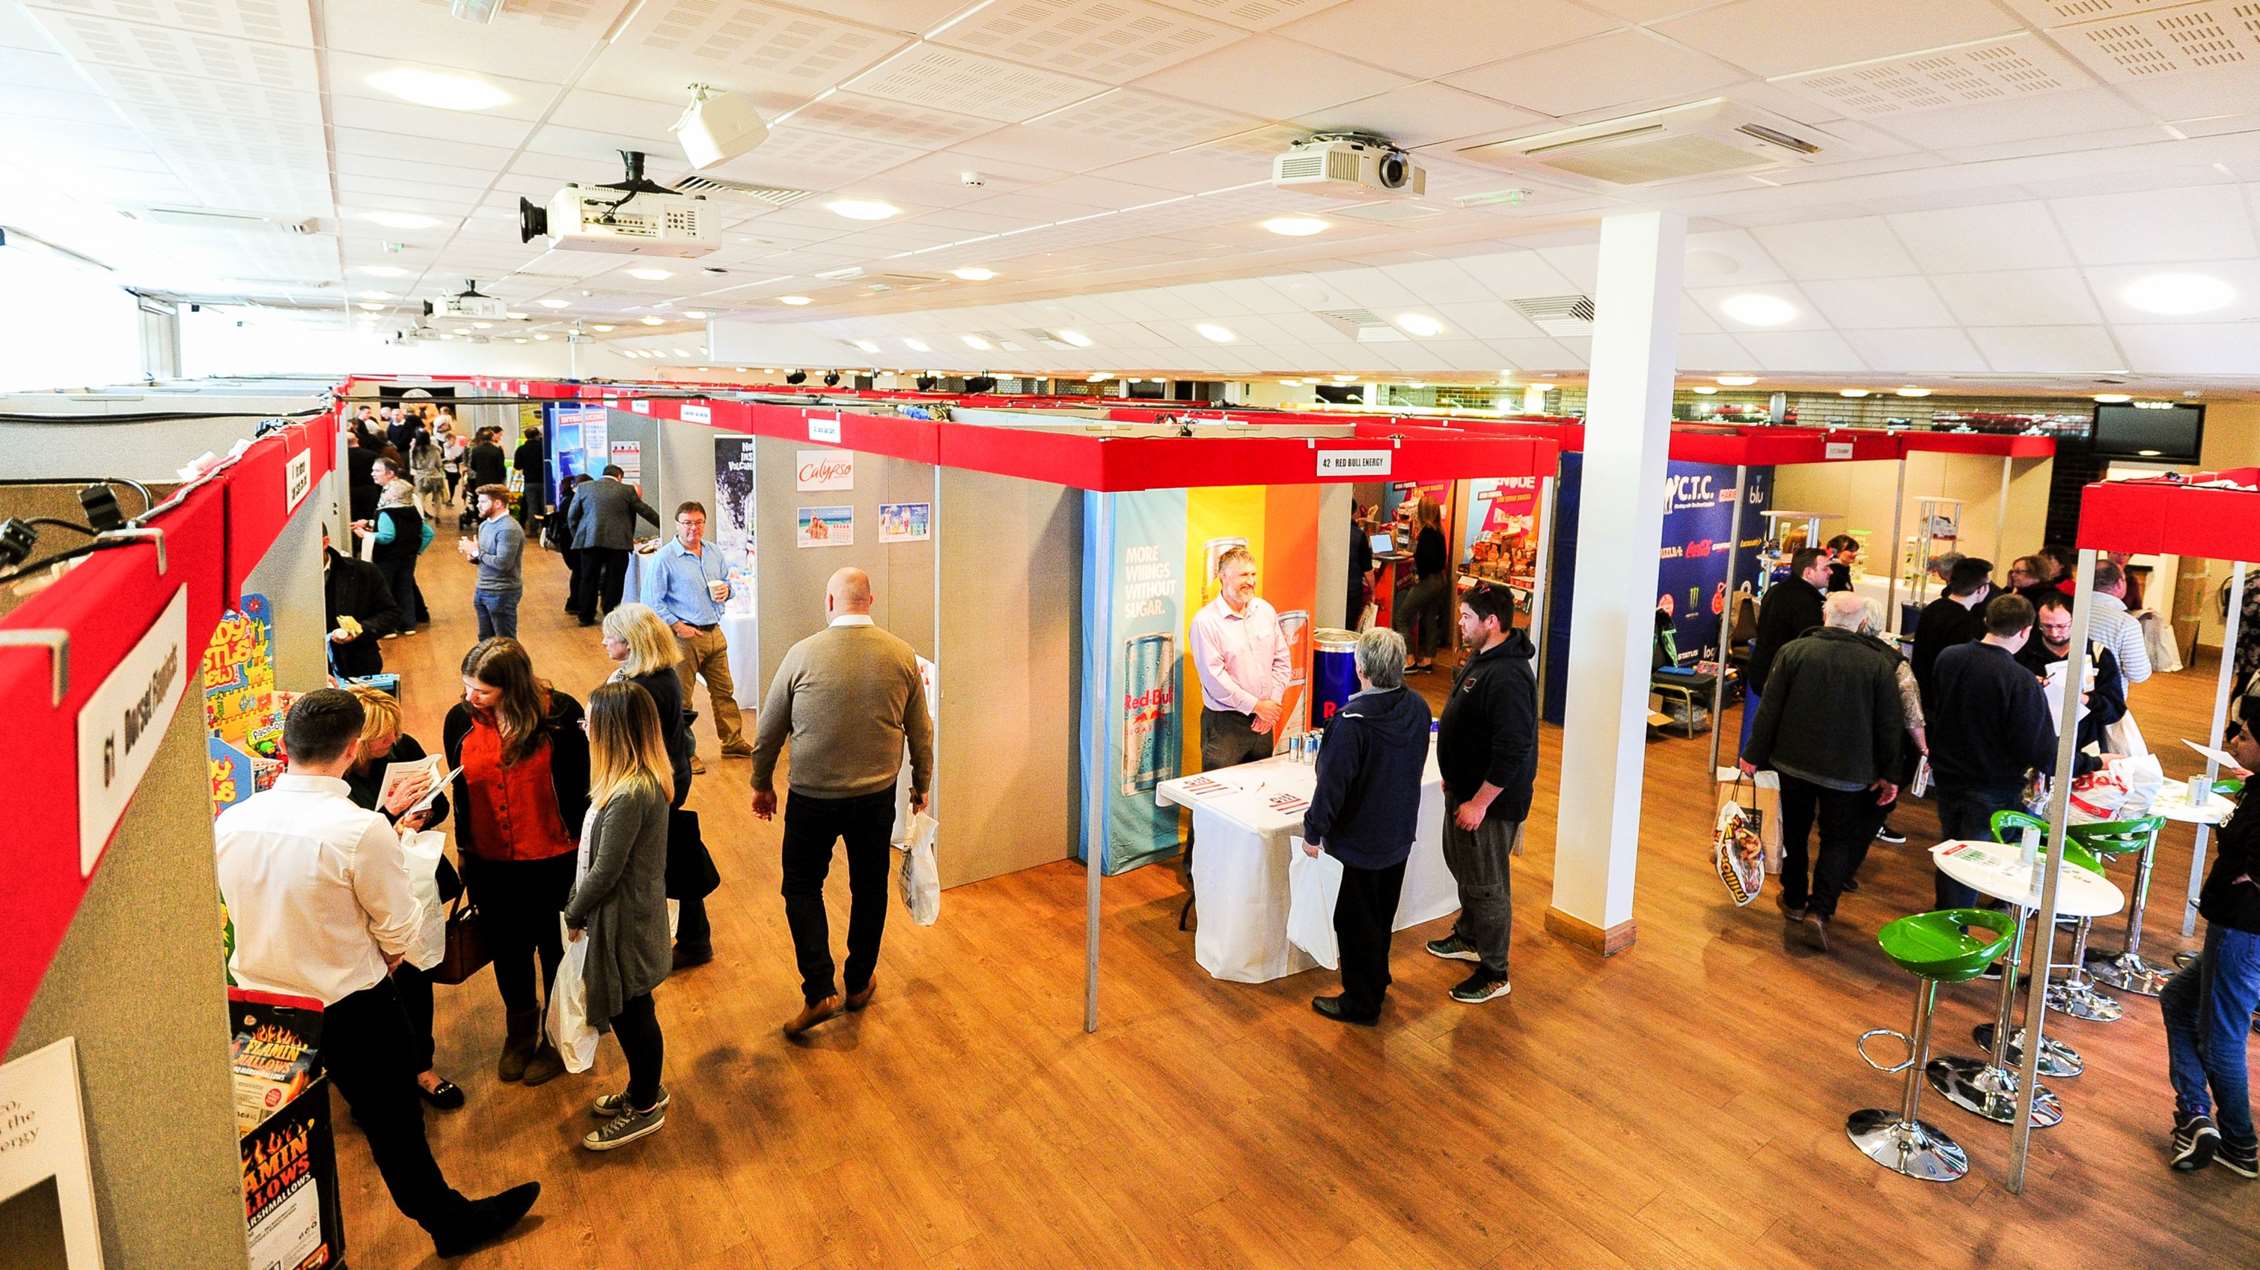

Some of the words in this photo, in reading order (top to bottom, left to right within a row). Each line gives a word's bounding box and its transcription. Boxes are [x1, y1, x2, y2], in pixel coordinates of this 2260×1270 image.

[799, 457, 852, 484] Calypso
[1323, 458, 1331, 468] 42
[1335, 458, 1347, 467] RED
[1348, 458, 1361, 467] BULL
[1362, 458, 1383, 467] ENERGY
[1749, 485, 1764, 504] blu
[1125, 545, 1160, 564] MORE
[1124, 579, 1177, 601] WITHOUT
[104, 729, 116, 789] 61
